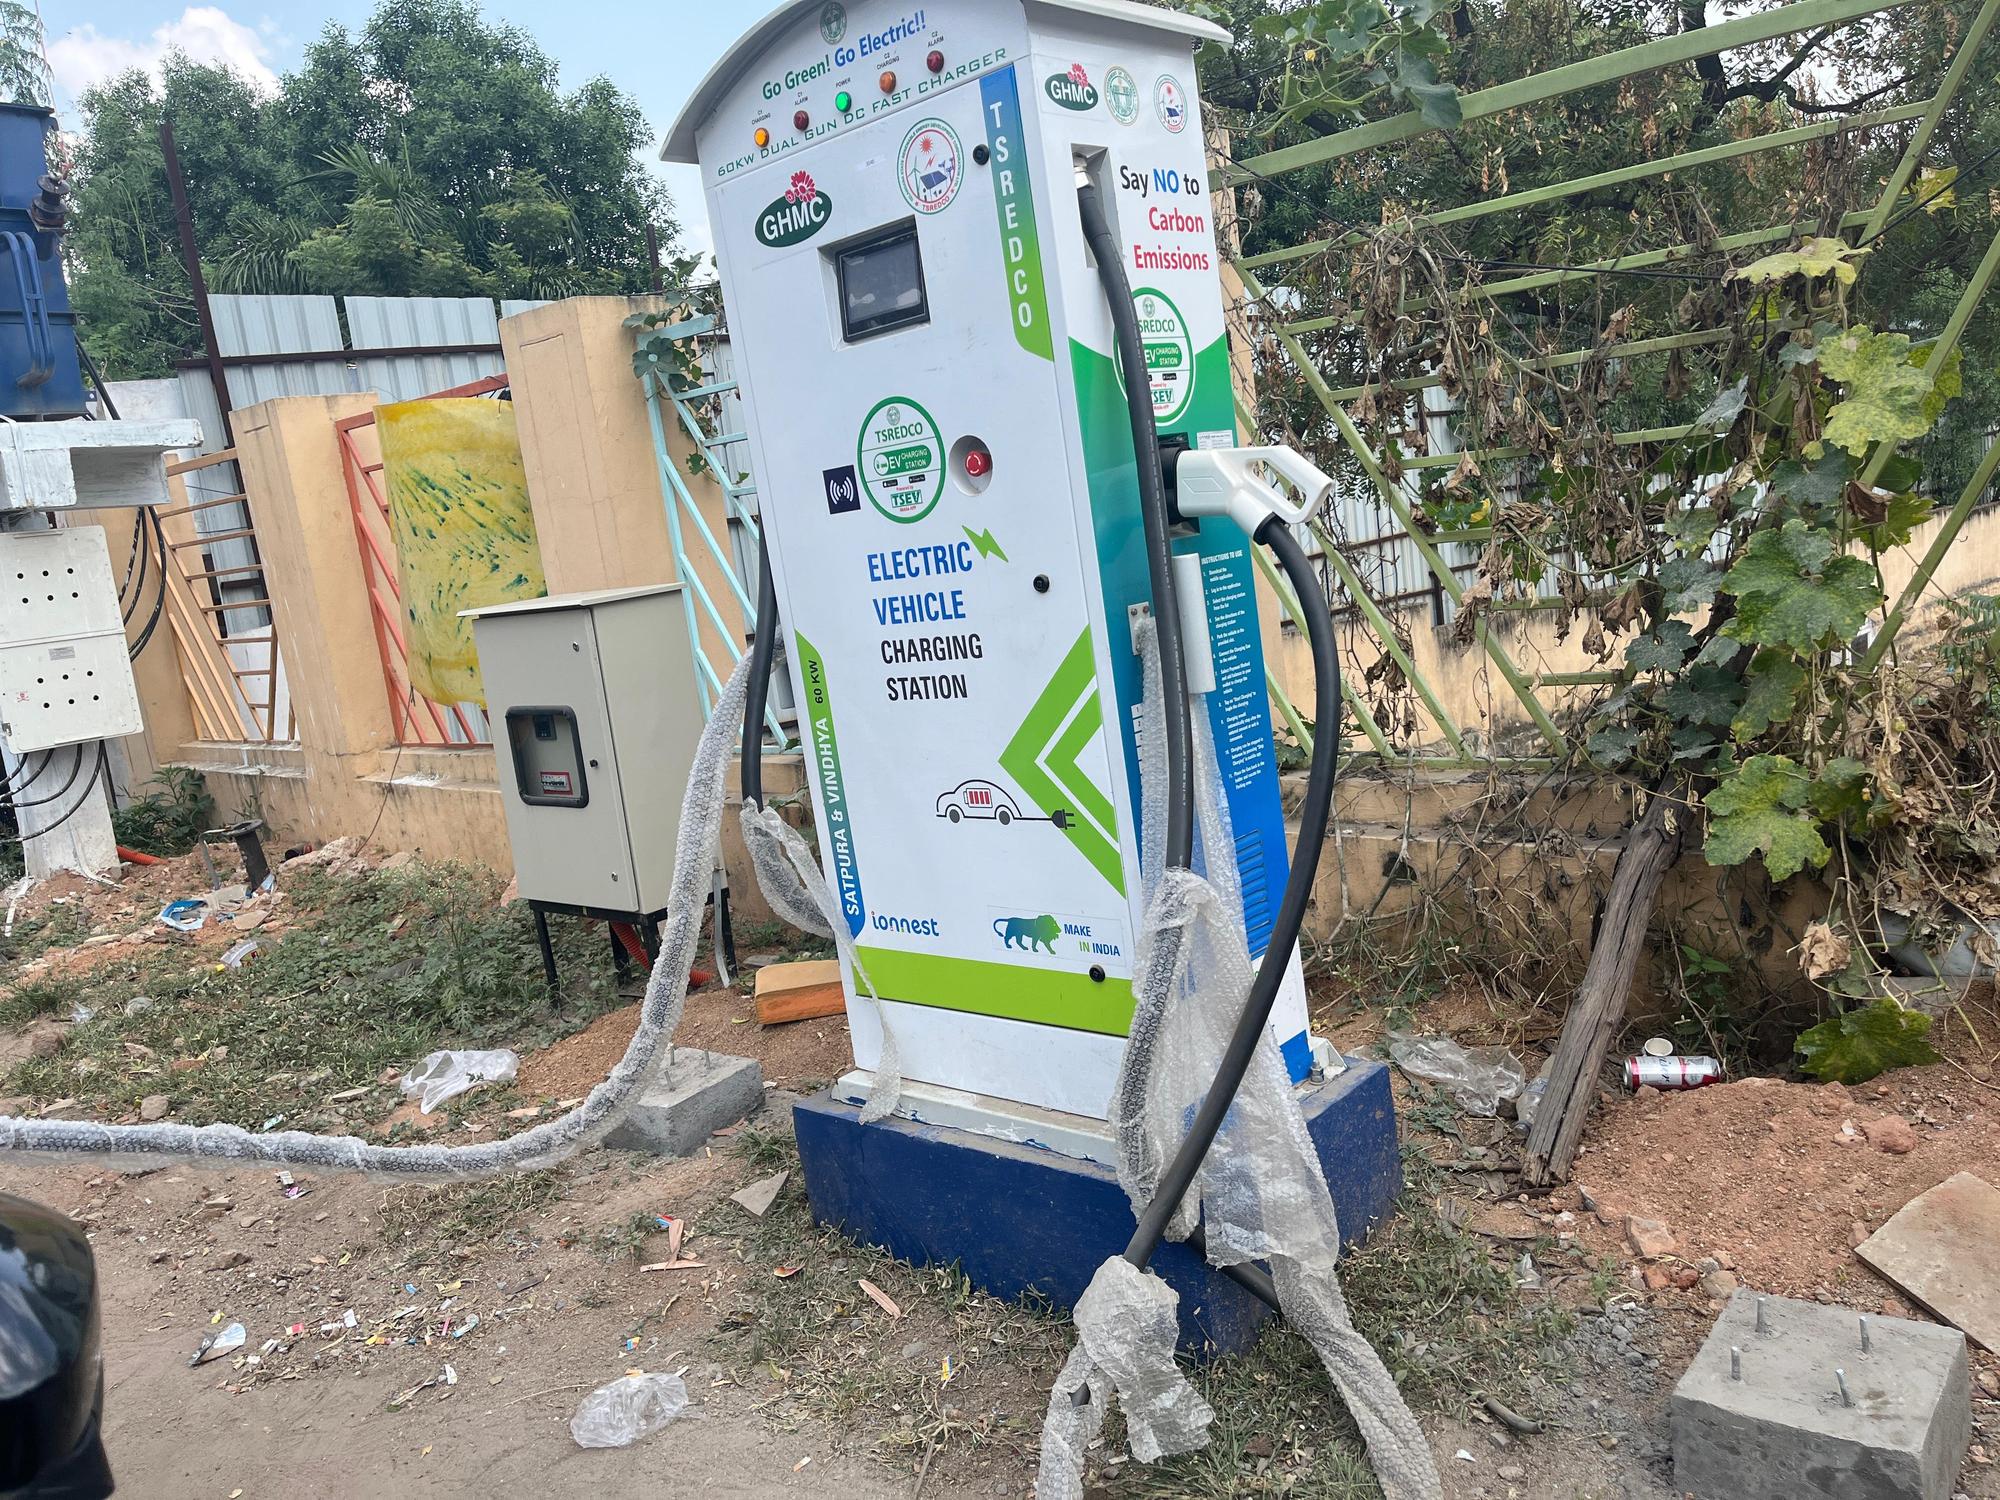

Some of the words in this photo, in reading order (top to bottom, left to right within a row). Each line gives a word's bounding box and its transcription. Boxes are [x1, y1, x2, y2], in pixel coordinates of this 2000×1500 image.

[927, 35, 944, 48] ALARM
[762, 81, 781, 100] Go
[784, 54, 831, 90] Green!
[834, 47, 856, 67] Go
[858, 9, 927, 58] Electric!!
[876, 56, 900, 70] CHARGING
[835, 77, 851, 88] POWER
[794, 96, 808, 106] ALARM
[1050, 80, 1095, 105] GHMC
[717, 152, 755, 177] 60KW
[760, 136, 799, 159] DUAL
[804, 119, 837, 141] GUN
[843, 107, 866, 124] DC
[872, 87, 911, 113] FAST
[918, 48, 1007, 94] CHARGER
[751, 112, 771, 125] CHARGING
[1120, 165, 1149, 198] Say
[1152, 168, 1180, 194] NO
[1183, 173, 1200, 196] to
[921, 195, 950, 212] TSREDCO
[762, 196, 825, 241] GHMC
[989, 101, 1033, 328] TSREDCO
[1148, 206, 1205, 234] Carbon
[1133, 244, 1210, 271] Emissions
[1138, 319, 1175, 333] SREDCO
[1156, 346, 1179, 355] CHARGING
[1159, 357, 1178, 366] STATION
[1152, 390, 1172, 403] SEV
[874, 421, 923, 443] TSREDCO
[889, 454, 901, 469] EV
[900, 448, 928, 460] CHARGING
[905, 459, 927, 469] STATION
[892, 491, 920, 506] TSEV
[867, 541, 973, 582] ELECTRIC
[1201, 552, 1230, 565] INSTRUCTIONS
[873, 590, 966, 625] VEHICLE
[880, 633, 983, 664] CHARGING
[807, 659, 821, 685] KW
[813, 687, 824, 704] 60
[886, 674, 968, 701] STATION
[815, 717, 839, 805] VINDHYA
[830, 808, 844, 823] &
[833, 828, 860, 917] SATPURA
[871, 910, 940, 938] ionnest
[1063, 923, 1092, 938] MAKE
[1079, 940, 1090, 953] IN
[1092, 942, 1121, 957] INDIA
